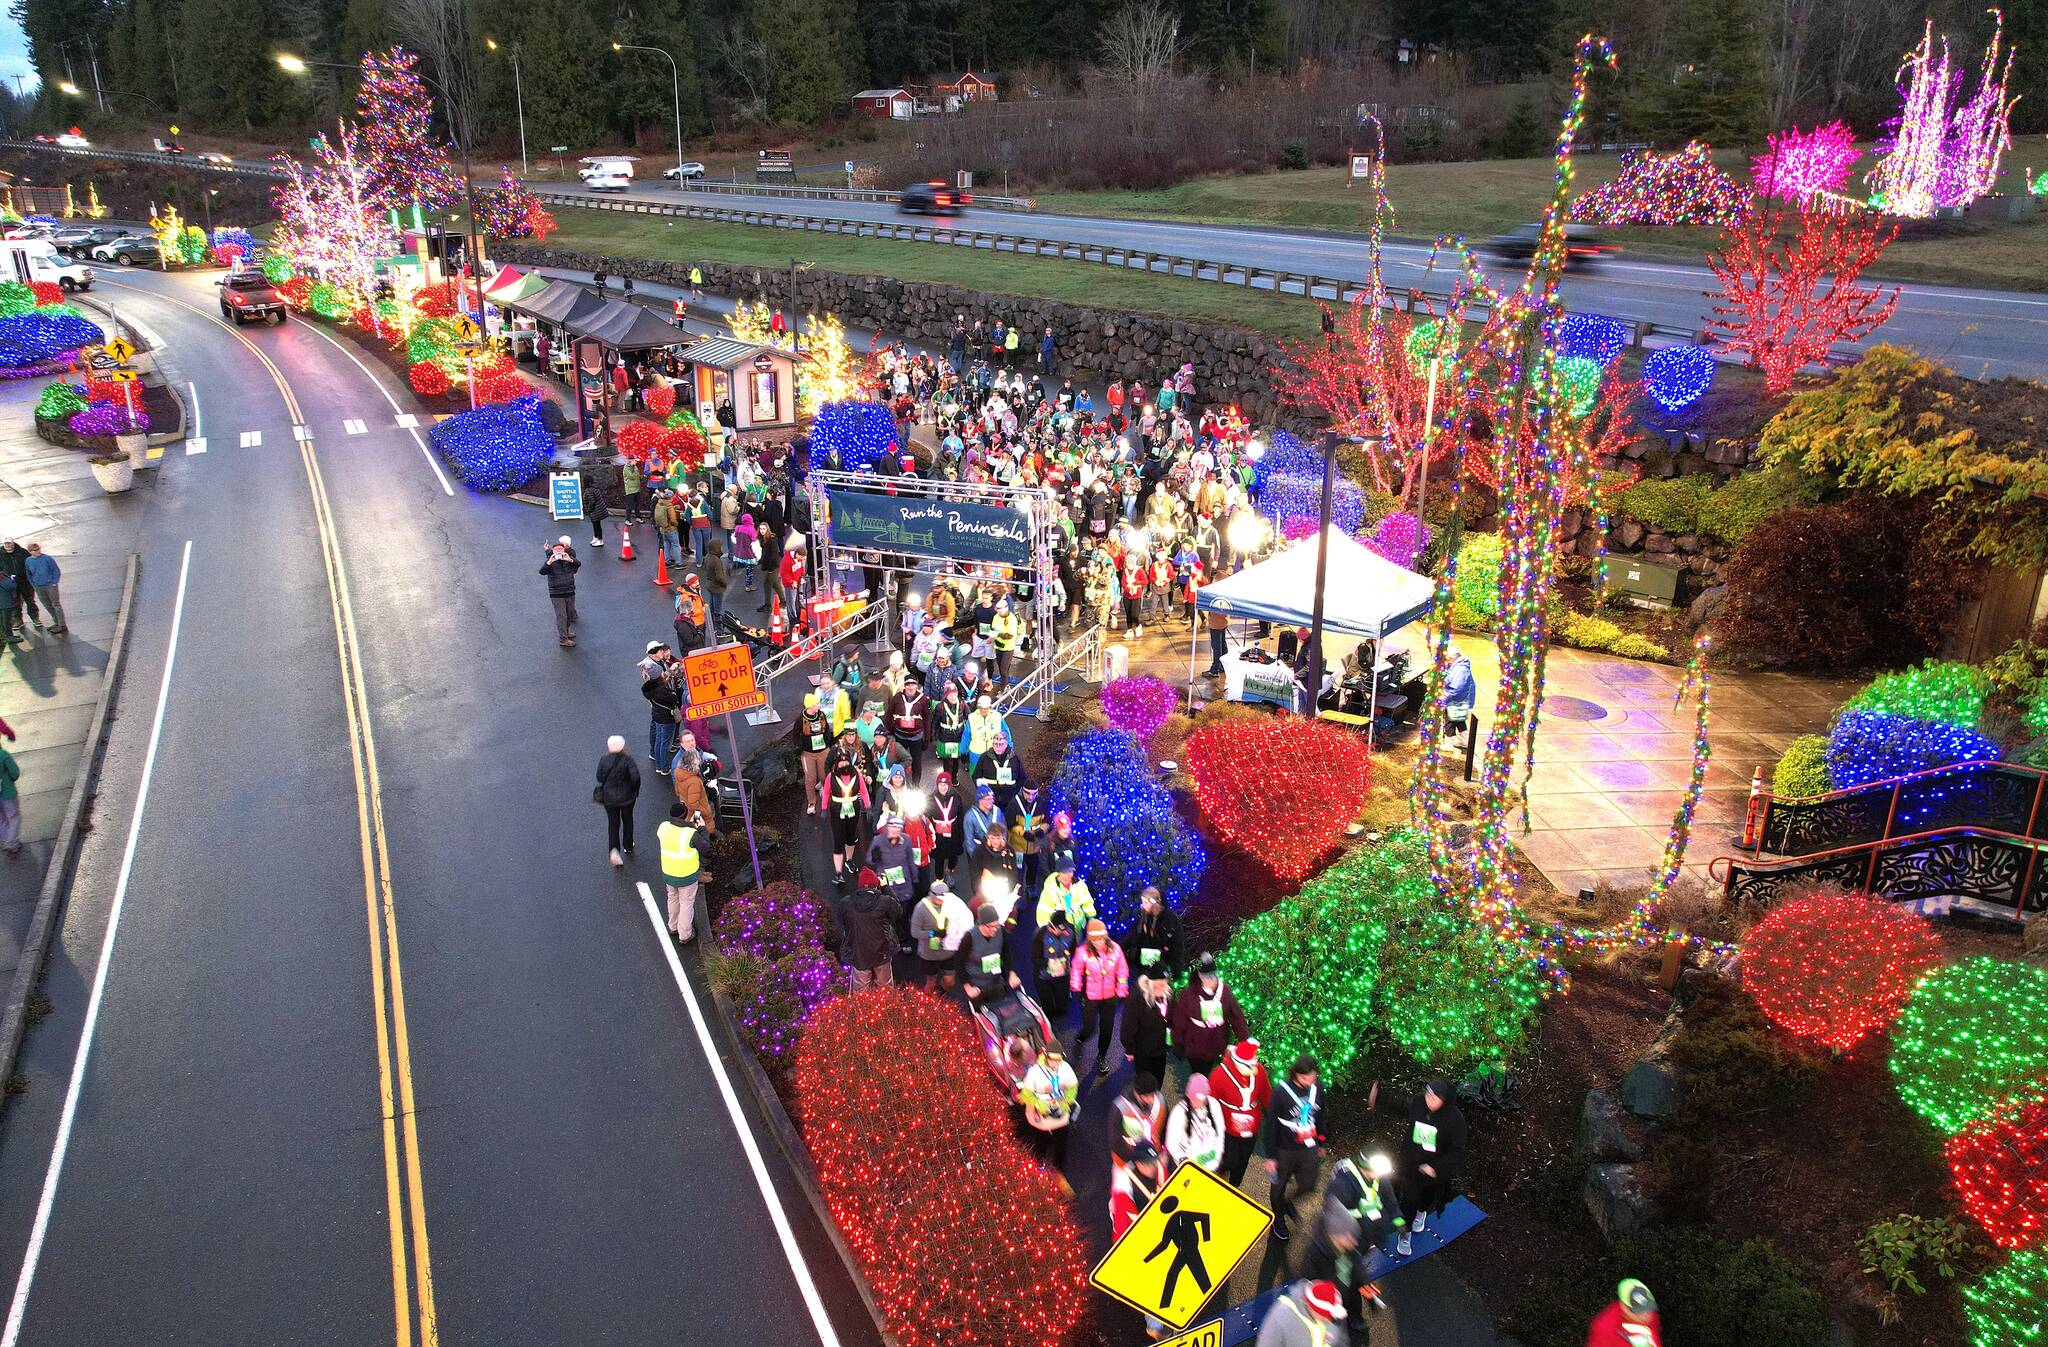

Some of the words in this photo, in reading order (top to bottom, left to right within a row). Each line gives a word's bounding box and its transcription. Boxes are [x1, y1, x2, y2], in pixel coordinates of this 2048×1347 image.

[900, 507, 926, 521] Run
[926, 503, 943, 518] the
[947, 511, 1027, 543] Peninsula
[1003, 549, 1025, 559] SERIES
[692, 665, 748, 687] DETOUR
[1254, 674, 1283, 684] MARATHON
[695, 706, 708, 717] US
[712, 701, 725, 713] 101
[728, 694, 758, 709] SOUTH
